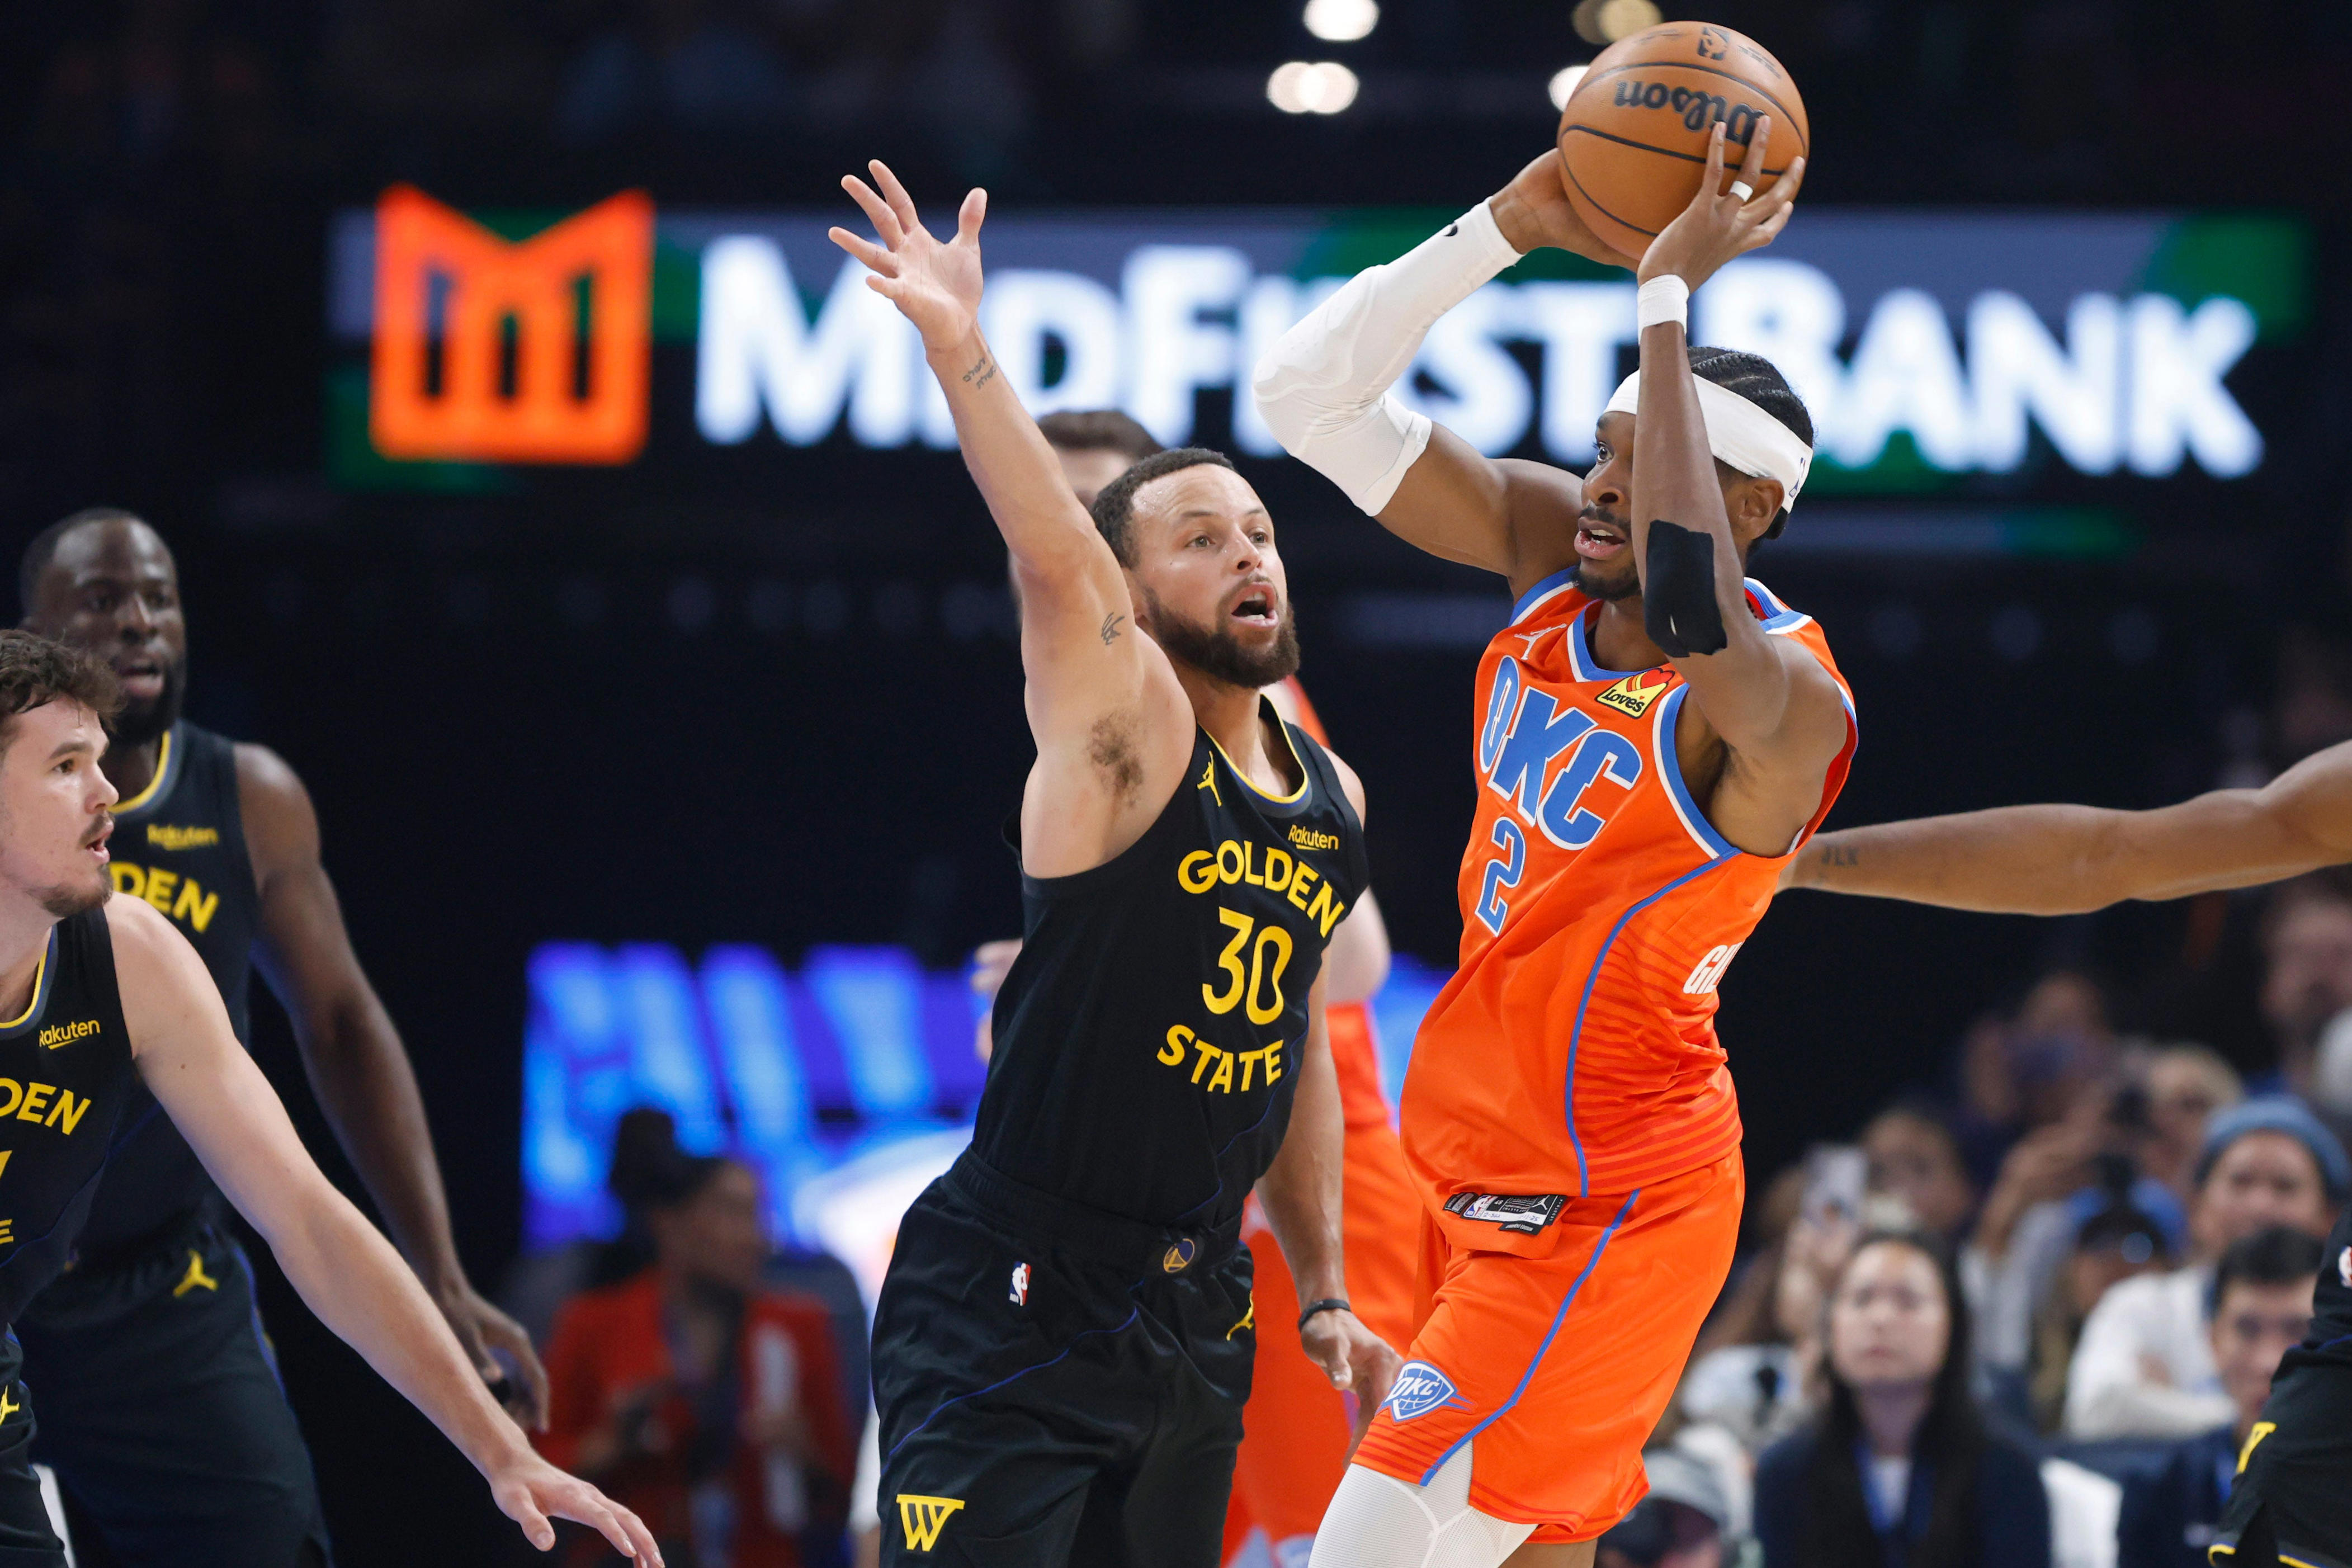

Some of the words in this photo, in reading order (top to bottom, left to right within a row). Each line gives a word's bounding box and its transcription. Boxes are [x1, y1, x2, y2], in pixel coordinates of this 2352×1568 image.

[1614, 80, 1766, 148] Wilson
[695, 233, 1640, 452] MDFIST
[1693, 257, 2265, 478] BANK
[1479, 654, 1643, 851] OKC
[1288, 824, 1339, 851] Rakuten
[1474, 816, 1527, 937] 2
[1178, 839, 1345, 939] GOLDEN
[1202, 906, 1293, 1026] 30
[39, 1019, 101, 1050] Rakuten
[1156, 1024, 1284, 1094] STATE
[1385, 1377, 1440, 1402] OKC
